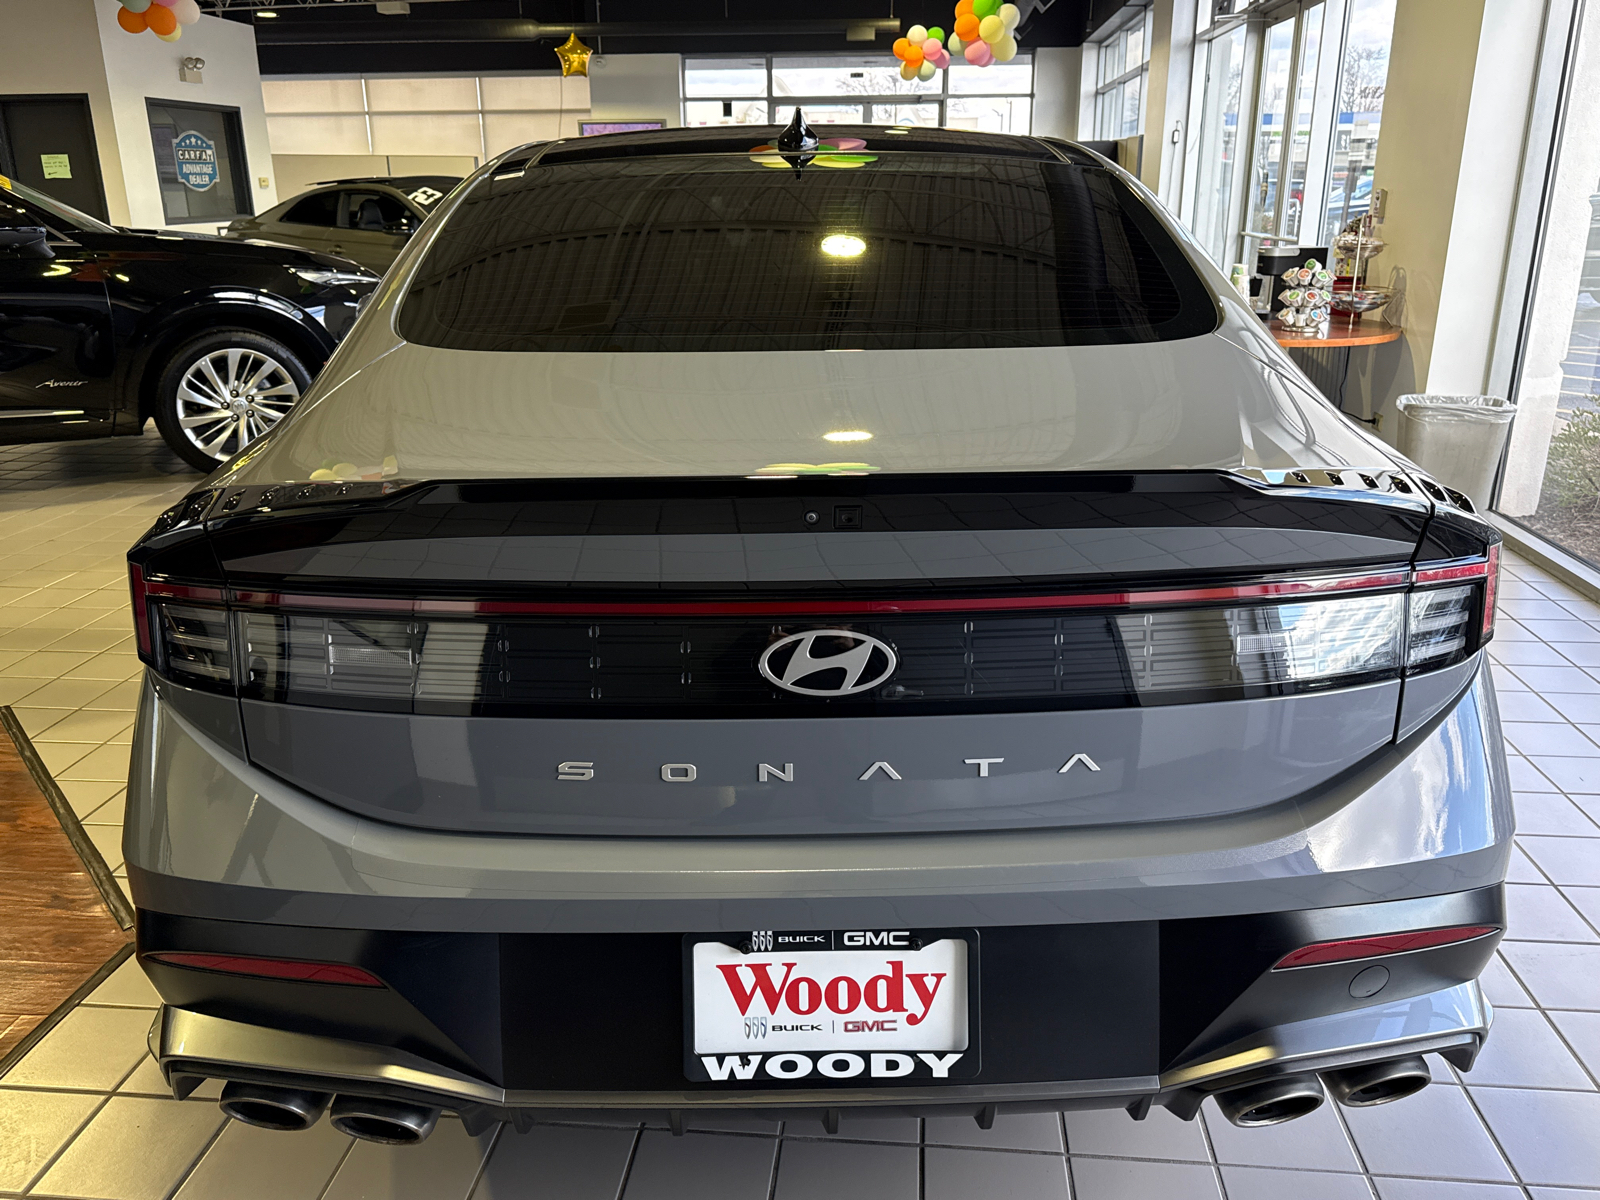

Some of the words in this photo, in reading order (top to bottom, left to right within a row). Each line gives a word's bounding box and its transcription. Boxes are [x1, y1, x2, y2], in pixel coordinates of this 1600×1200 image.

[182, 163, 214, 174] ADVANTAGE
[189, 174, 210, 185] DEALER
[35, 378, 88, 389] Avenir
[557, 753, 1101, 782] SONATA
[778, 935, 826, 943] BUICK
[843, 931, 910, 946] GMC
[716, 960, 947, 1026] Woody
[771, 1024, 823, 1032] BUICK
[843, 1019, 898, 1033] GMC
[700, 1052, 964, 1081] WOODY
